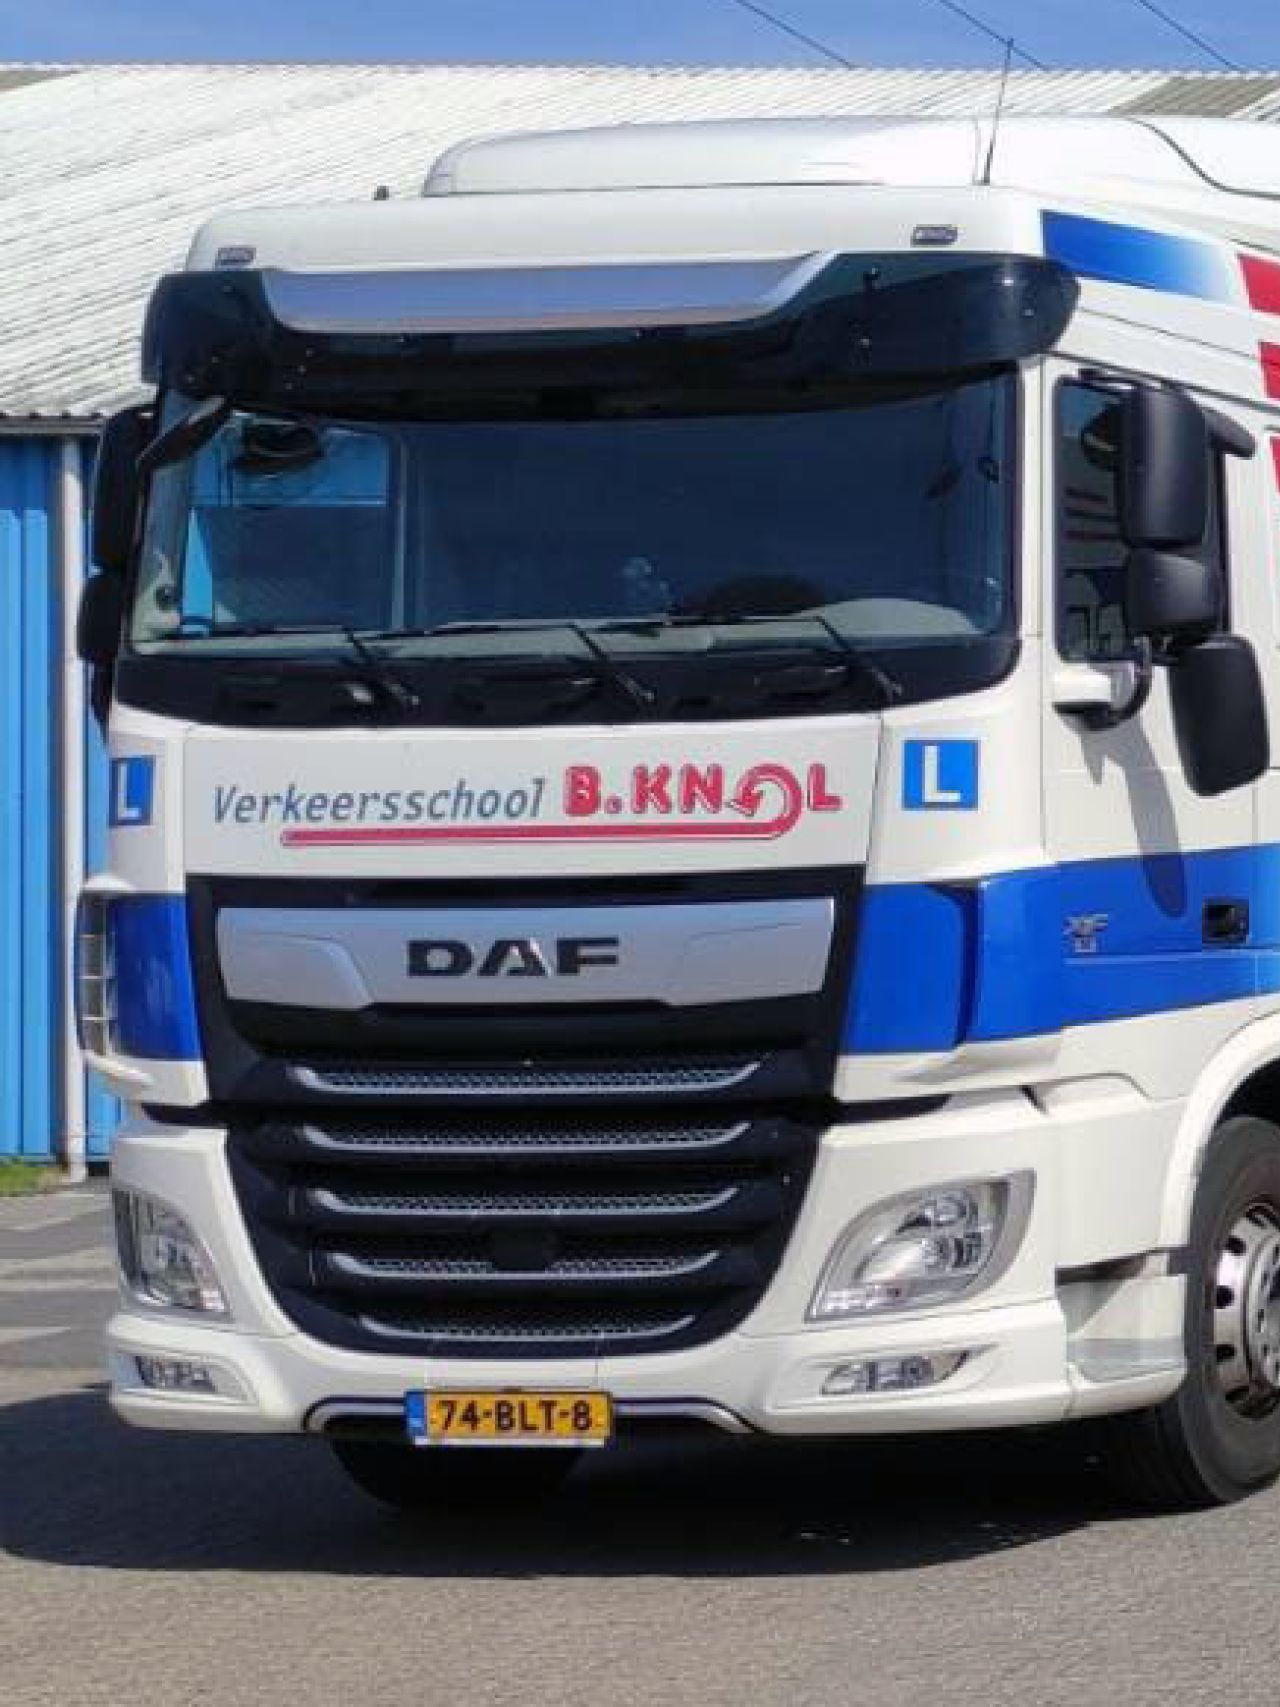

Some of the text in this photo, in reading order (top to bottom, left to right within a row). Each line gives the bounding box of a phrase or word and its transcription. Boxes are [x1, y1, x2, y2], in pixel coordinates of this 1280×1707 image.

[117, 763, 142, 820] L
[923, 745, 960, 803] L
[215, 779, 543, 822] Verkeersschool
[408, 939, 619, 976] DAF
[439, 1400, 592, 1431] 74-BLT-8
